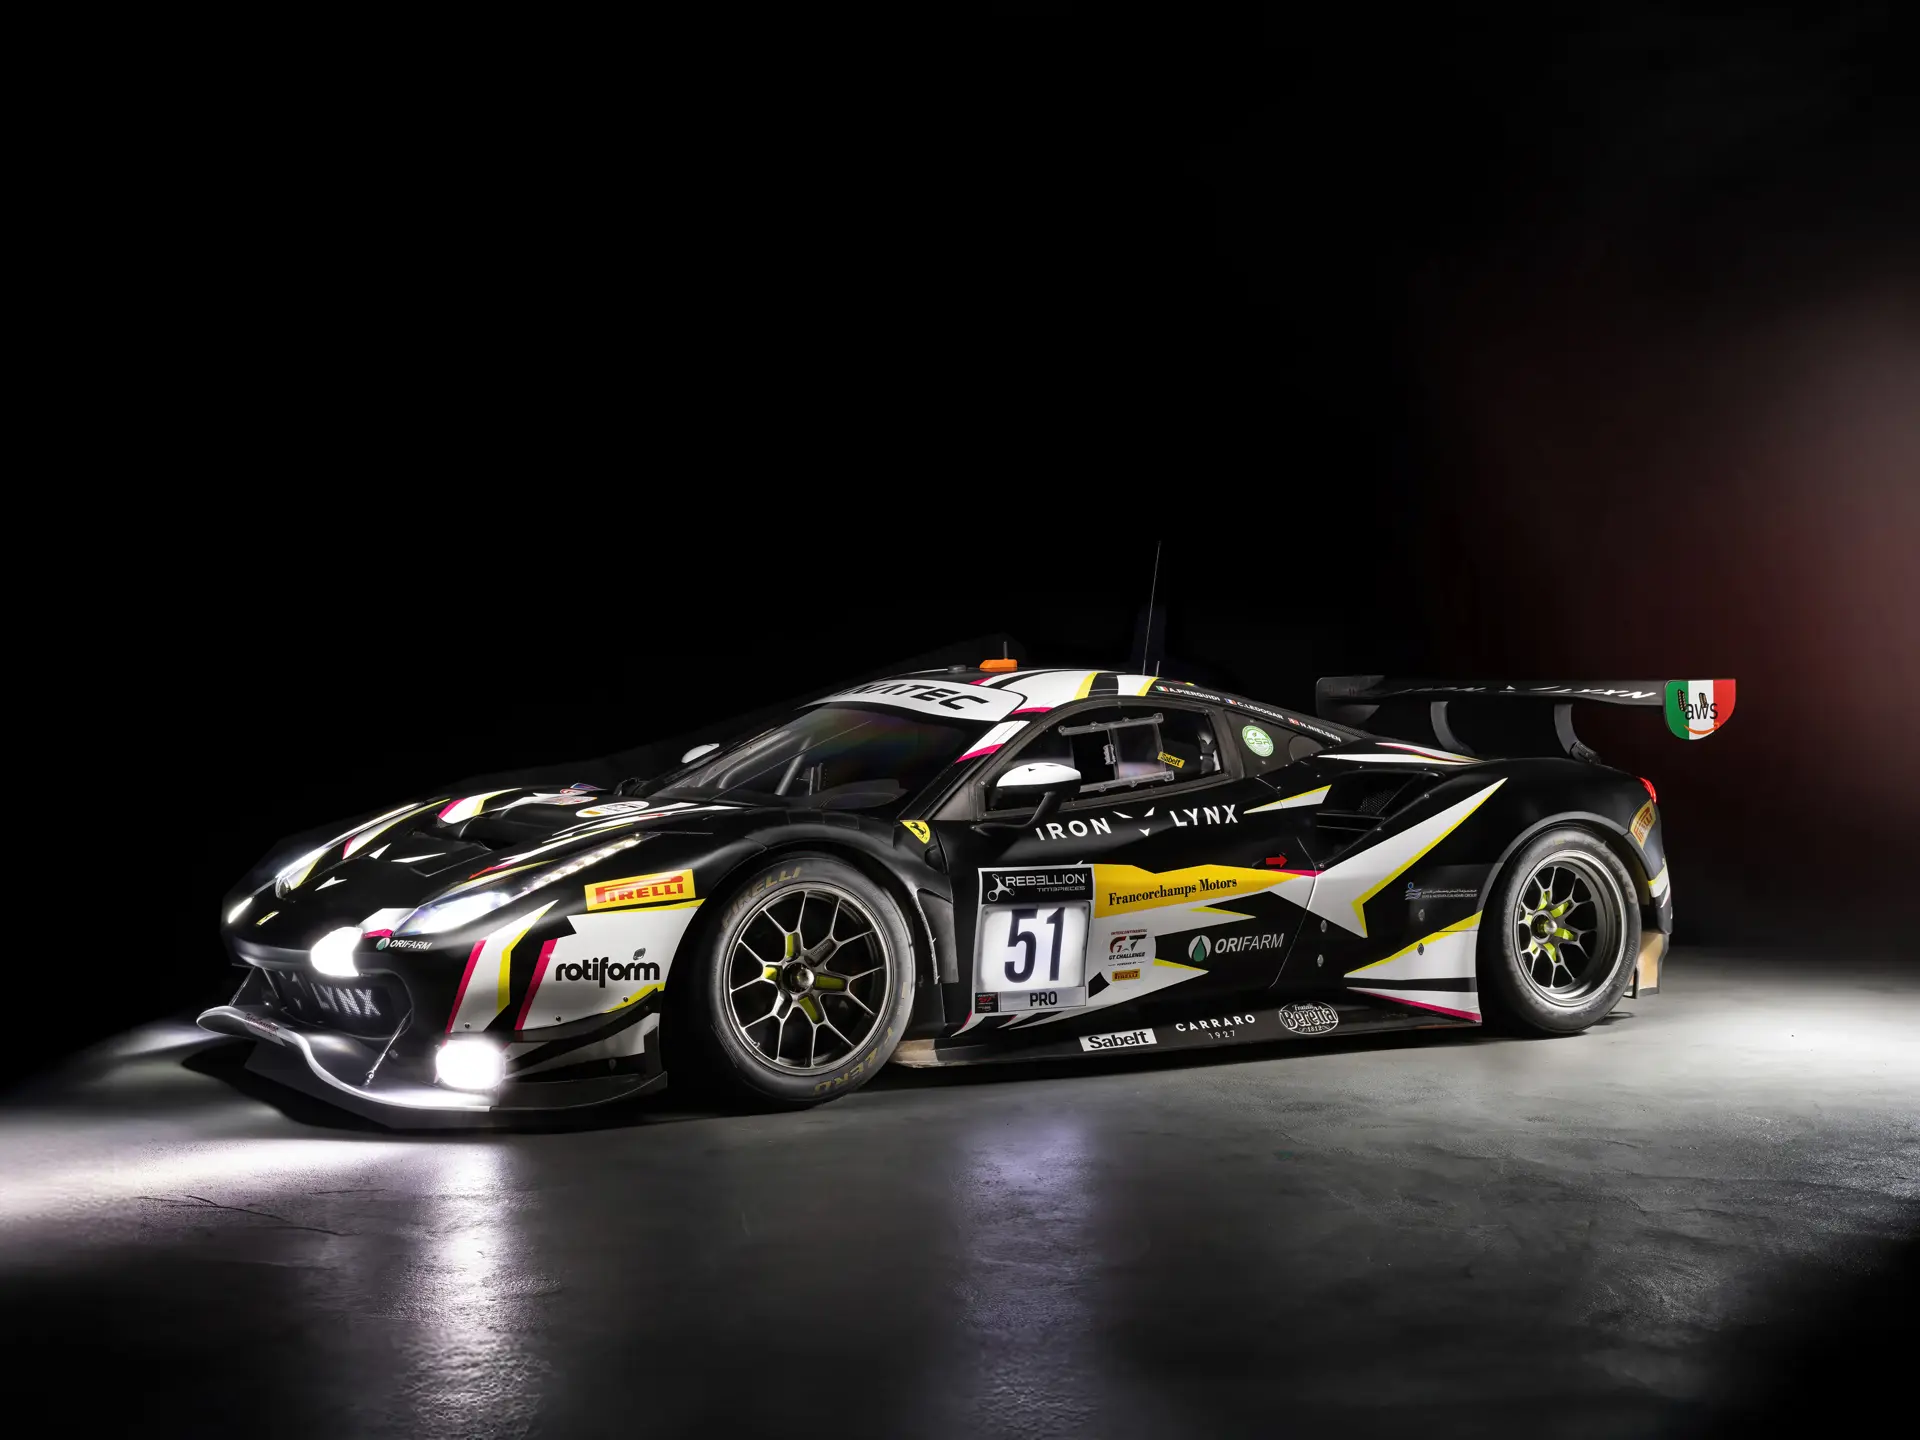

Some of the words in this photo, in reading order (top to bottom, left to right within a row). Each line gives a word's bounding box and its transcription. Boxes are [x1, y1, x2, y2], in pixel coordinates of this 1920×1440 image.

[1685, 702, 1718, 720] aws
[1246, 737, 1271, 746] CSR
[1035, 817, 1112, 841] IRON
[1169, 804, 1239, 827] LYNX
[1005, 873, 1086, 887] REBELLION
[595, 875, 684, 904] PIRELLI
[1108, 883, 1197, 907] Francorchamps
[1199, 878, 1237, 892] Motors
[389, 939, 433, 951] ORIFARM
[1004, 906, 1066, 983] 51
[1215, 932, 1285, 954] ORIFARM
[1116, 951, 1146, 960] CHALLENGE
[555, 957, 661, 988] rotiform
[310, 982, 382, 1018] LYNX
[1029, 991, 1058, 1006] PRO
[1175, 1014, 1256, 1032] CARRARO
[1279, 1006, 1339, 1030] Beretta
[1087, 1031, 1149, 1049] Sabelt
[1208, 1030, 1236, 1040] 1927
